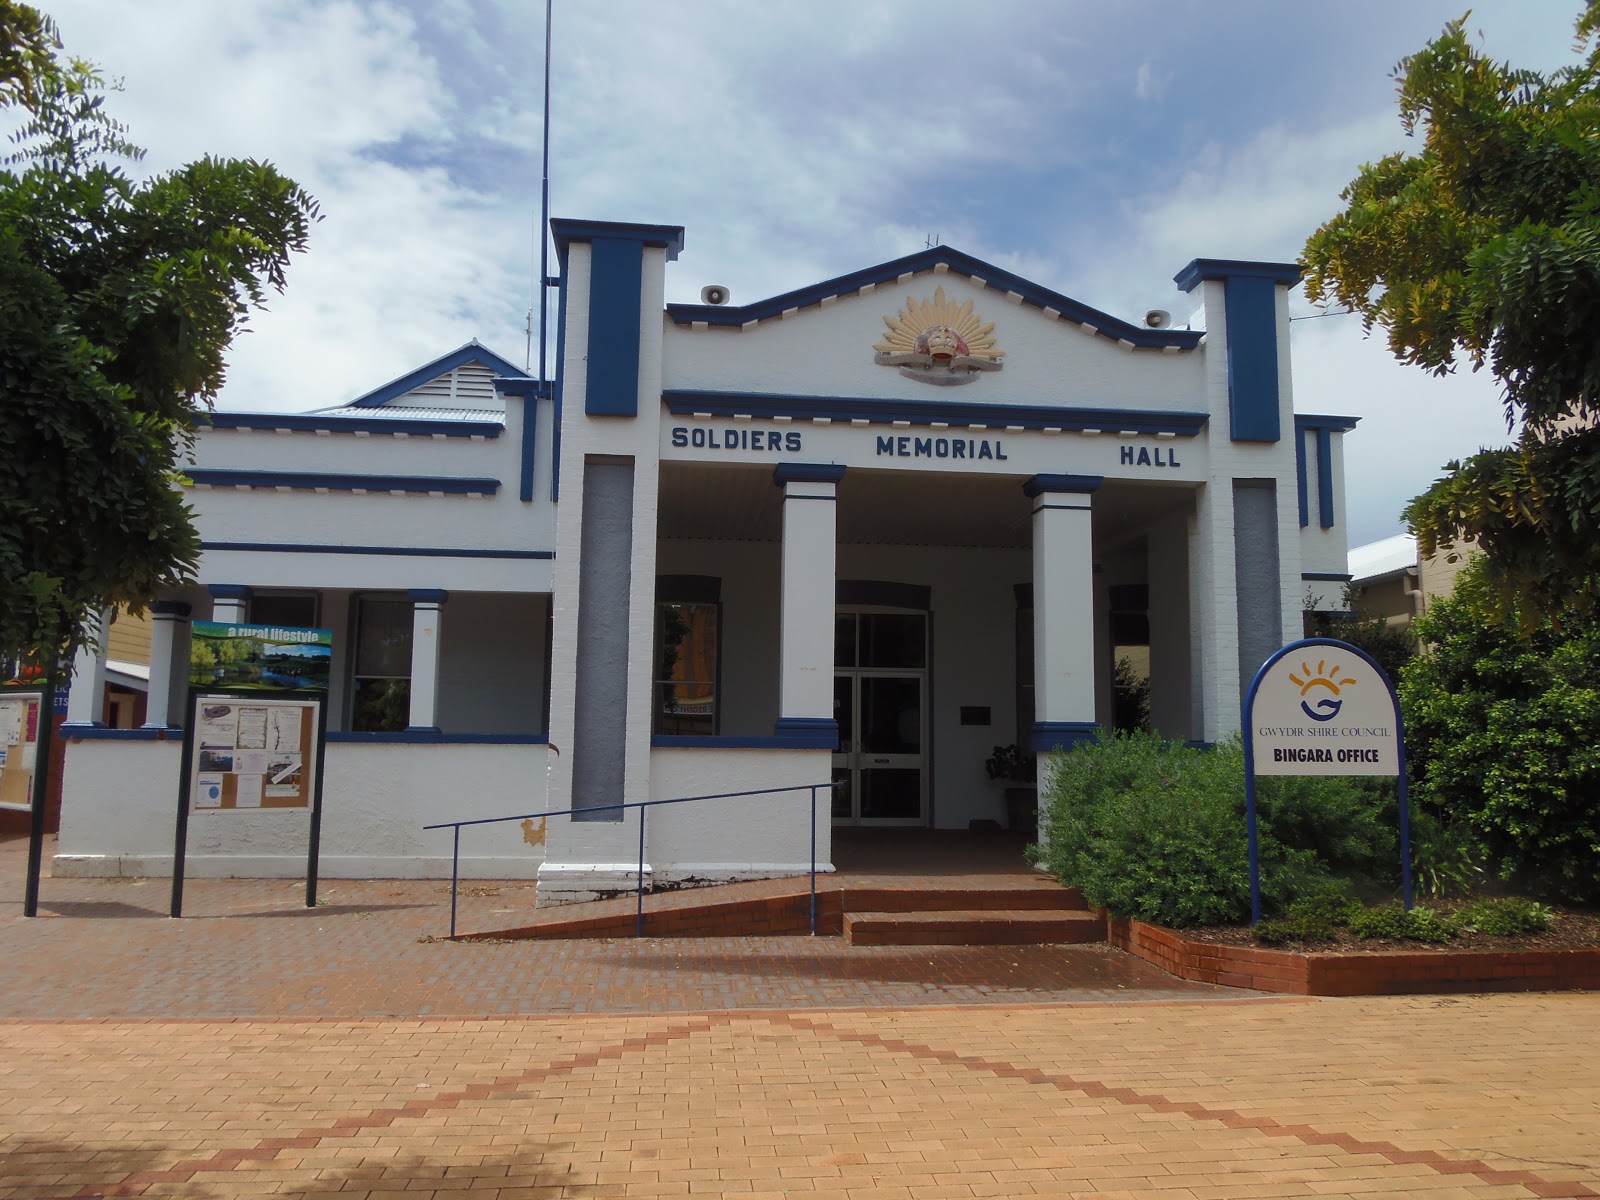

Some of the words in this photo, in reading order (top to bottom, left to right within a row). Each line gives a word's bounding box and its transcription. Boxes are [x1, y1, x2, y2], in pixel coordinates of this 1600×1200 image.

[671, 427, 802, 452] SOLDIERS
[876, 436, 1008, 461] MEMORIAL
[1120, 446, 1181, 468] HALL
[227, 627, 236, 637] a
[238, 628, 269, 640] rural
[270, 628, 319, 643] lifestyle
[54, 684, 69, 693] LIC
[53, 697, 69, 707] ETS
[1259, 727, 1304, 737] GWYDIR
[1307, 727, 1338, 737] SHIRE
[1341, 727, 1391, 737] COUNCIL
[1273, 748, 1333, 763] BINGARA
[1337, 748, 1379, 763] OFFICE
